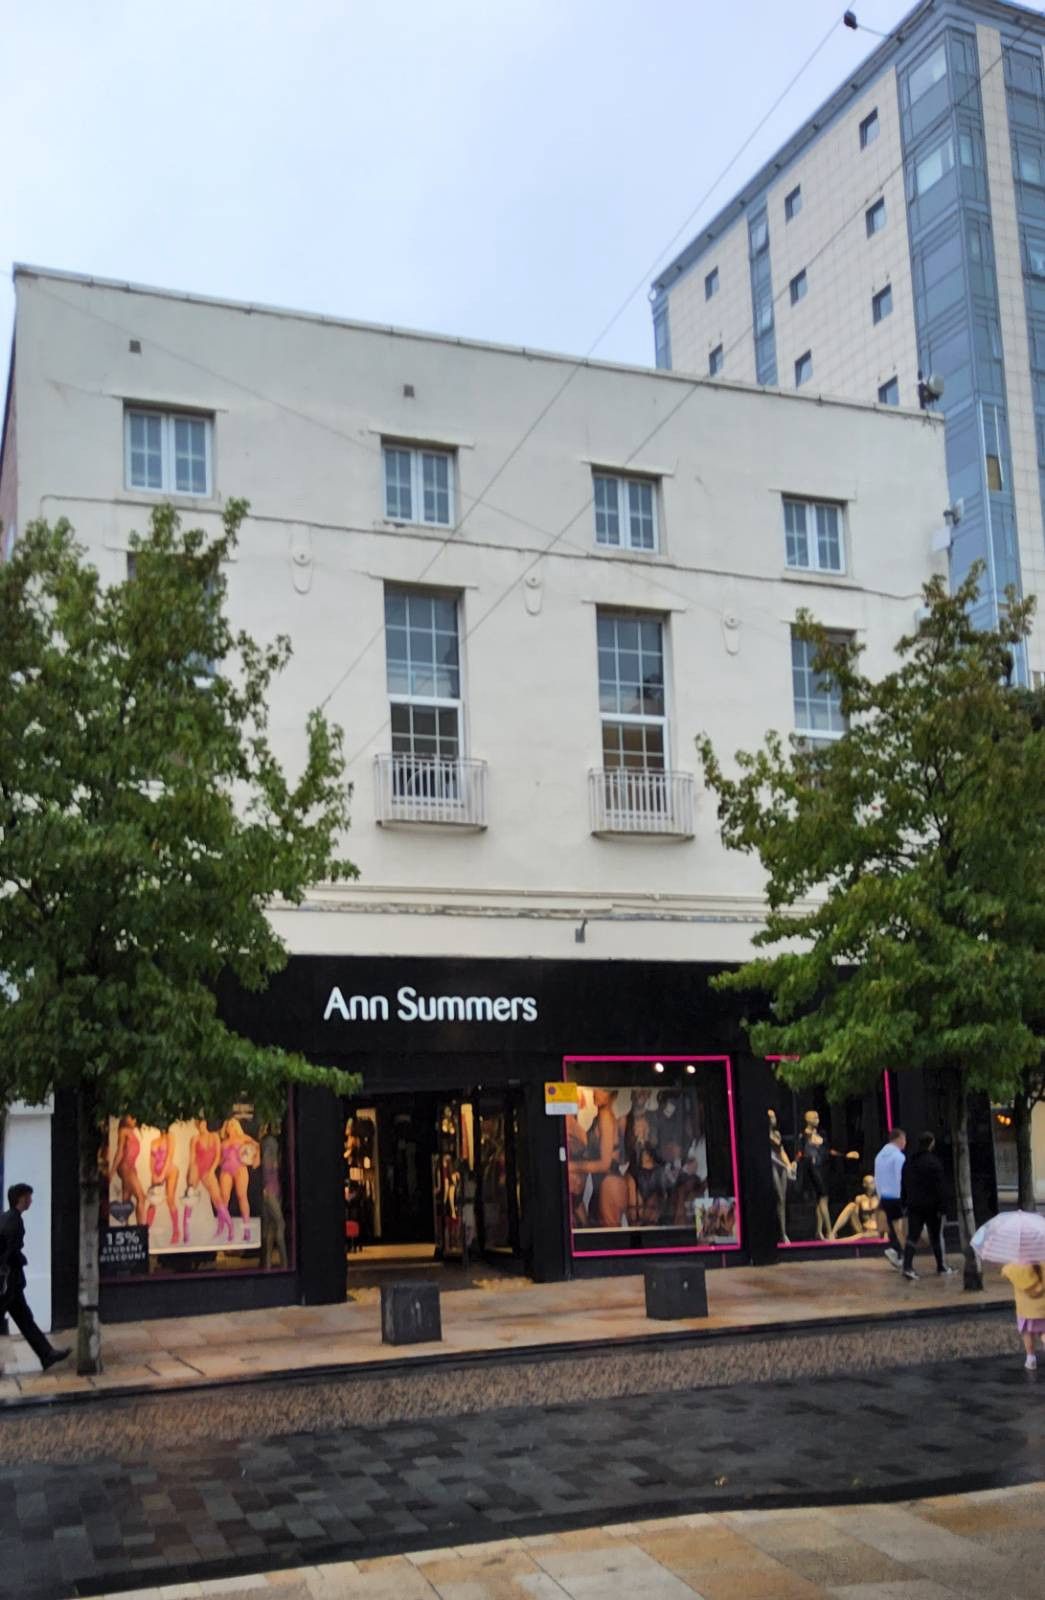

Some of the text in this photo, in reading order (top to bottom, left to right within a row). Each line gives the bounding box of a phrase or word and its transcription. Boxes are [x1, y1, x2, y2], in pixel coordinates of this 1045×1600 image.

[323, 986, 538, 1021] Ann Summers
[106, 1231, 140, 1245] 15%
[102, 1245, 143, 1254] STUDENT
[100, 1252, 146, 1262] DISCOUNT
